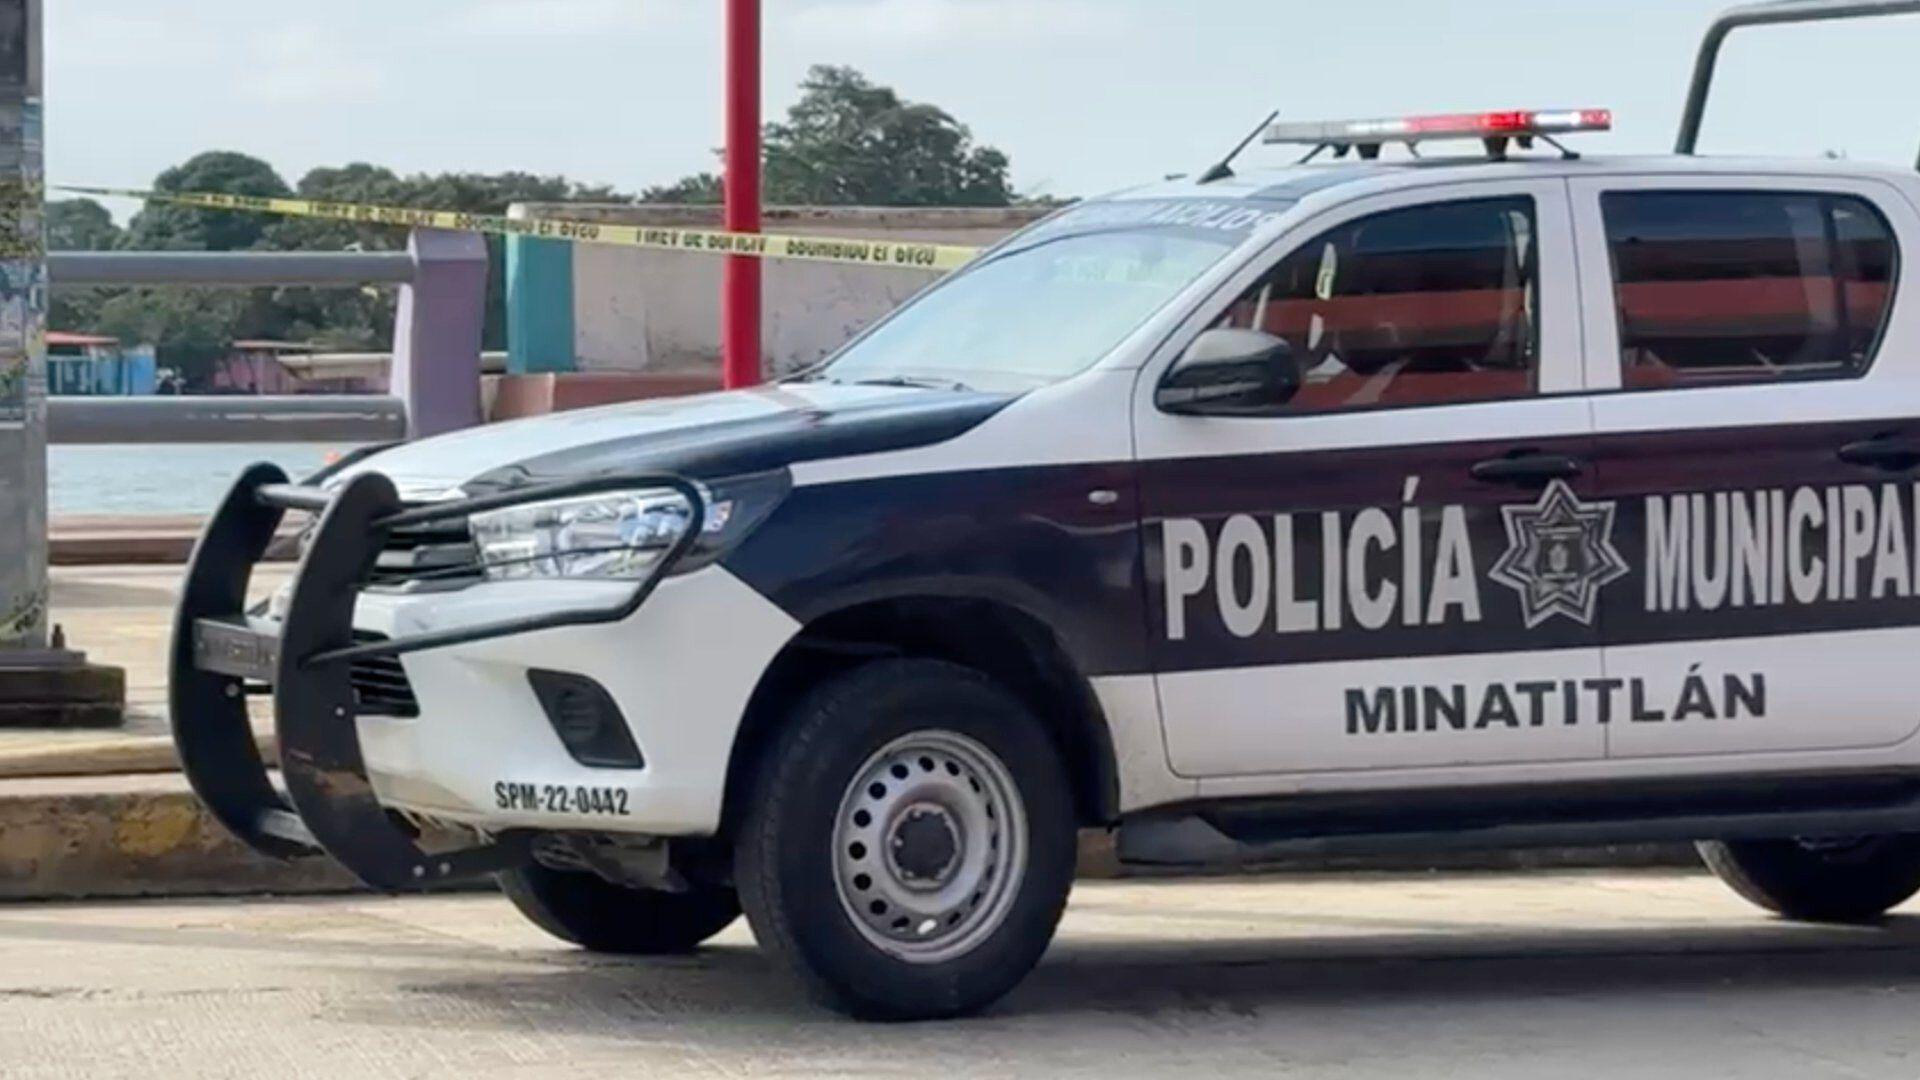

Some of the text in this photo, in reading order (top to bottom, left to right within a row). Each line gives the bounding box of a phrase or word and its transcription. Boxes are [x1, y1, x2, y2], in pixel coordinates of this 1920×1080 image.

[1162, 476, 1920, 640] POLICÍA MUNICIPA
[1344, 662, 1766, 735] MINATITLÁN
[494, 780, 631, 816] SPM-22-0442
